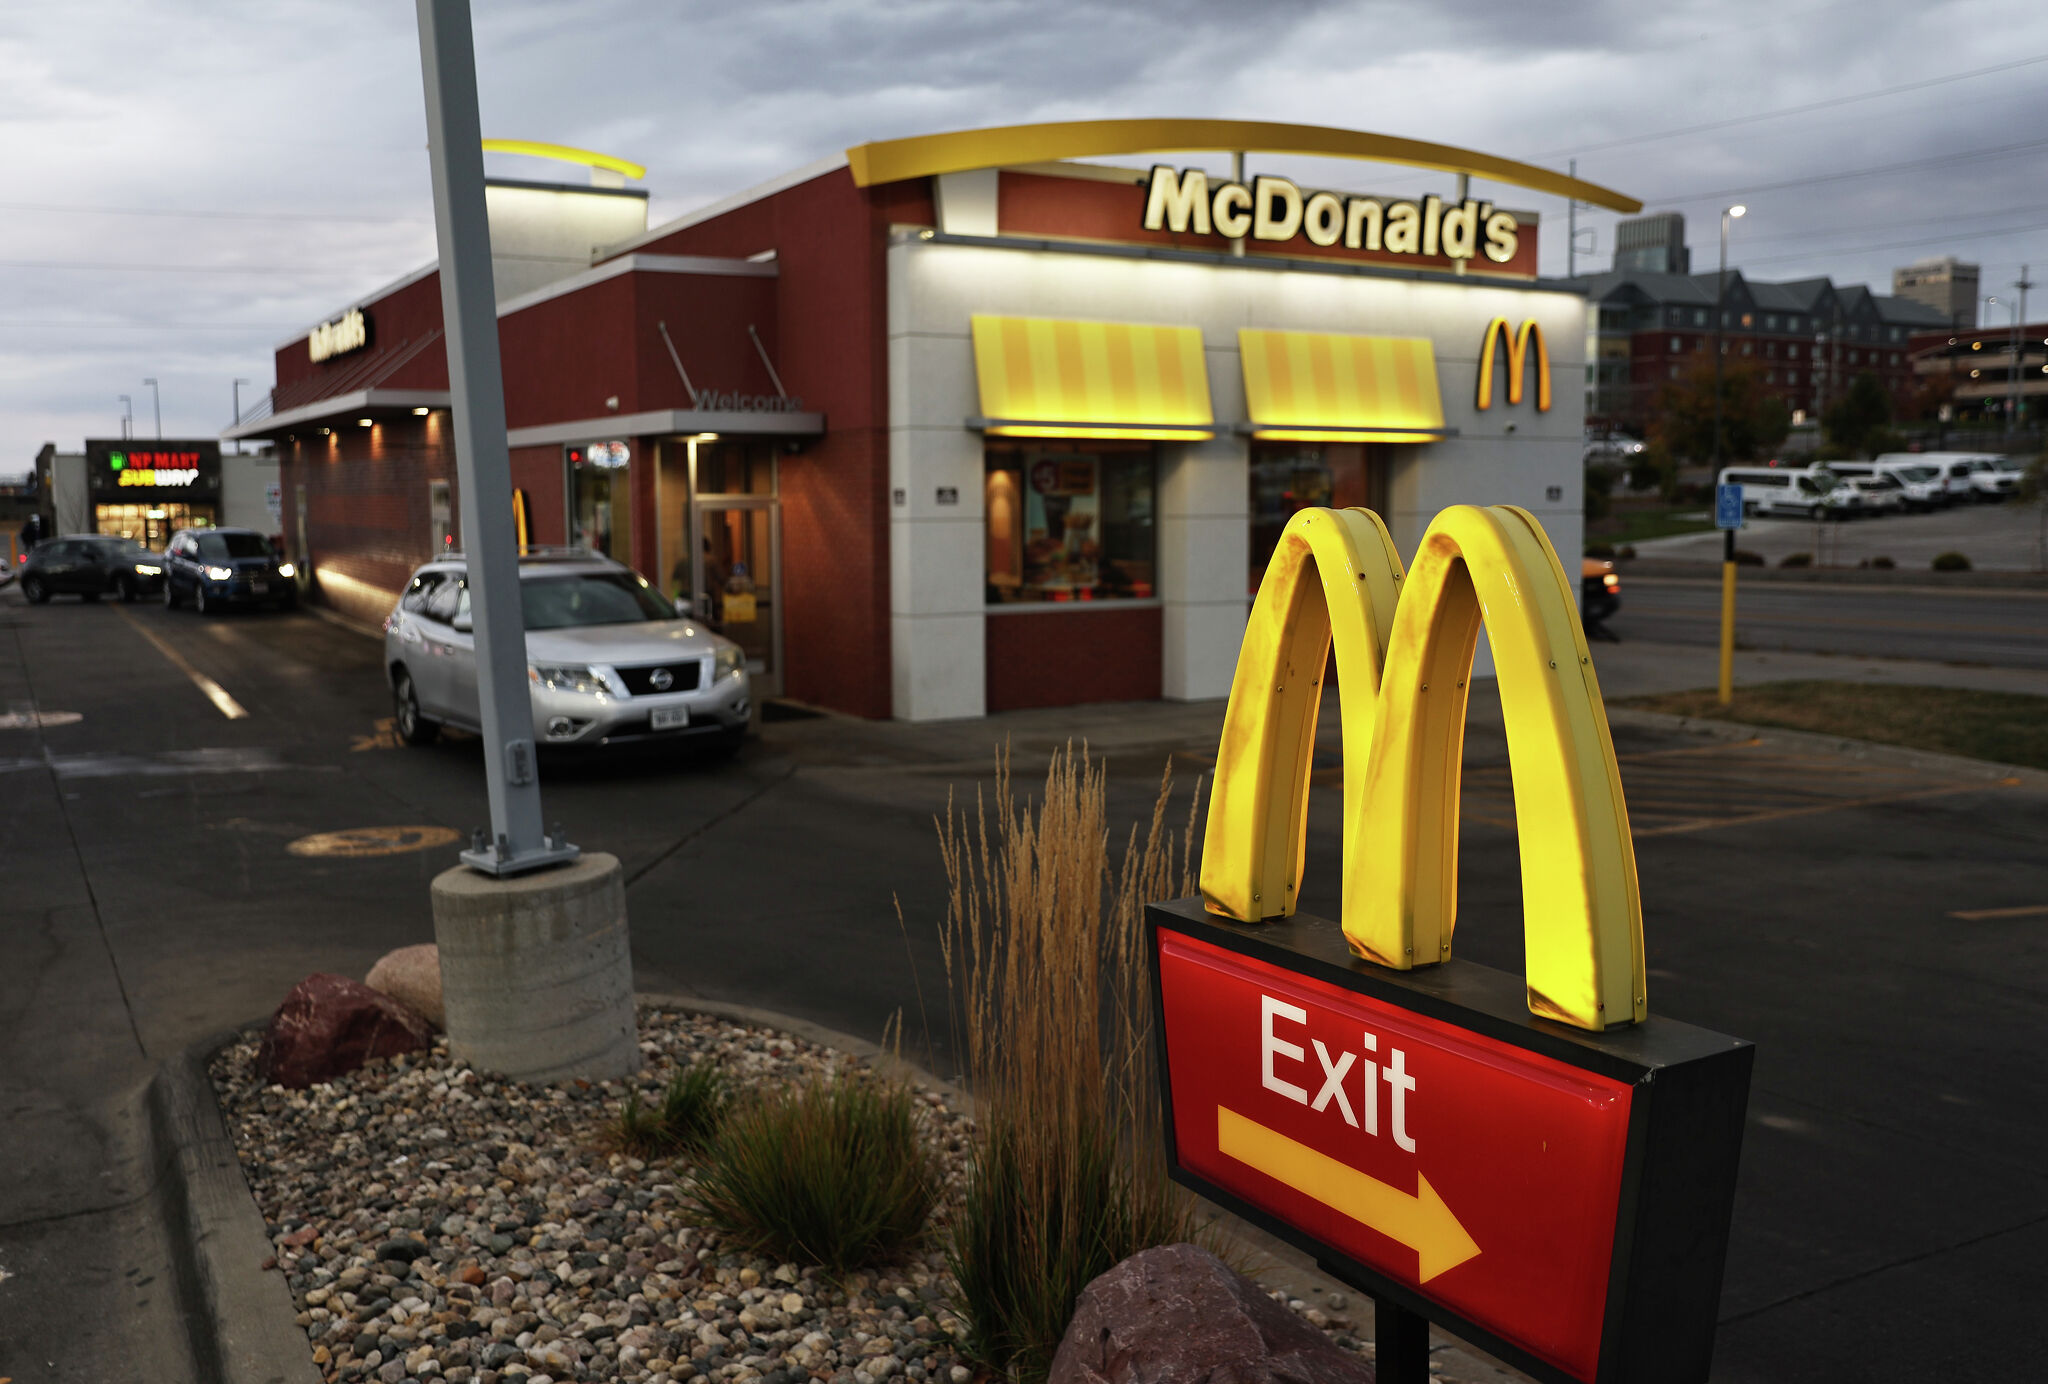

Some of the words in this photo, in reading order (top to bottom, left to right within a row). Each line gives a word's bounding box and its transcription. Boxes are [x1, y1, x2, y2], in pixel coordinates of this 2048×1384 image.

[1143, 165, 1519, 263] McDonald's
[695, 388, 803, 412] Welcome
[1261, 993, 1416, 1154] Exit
